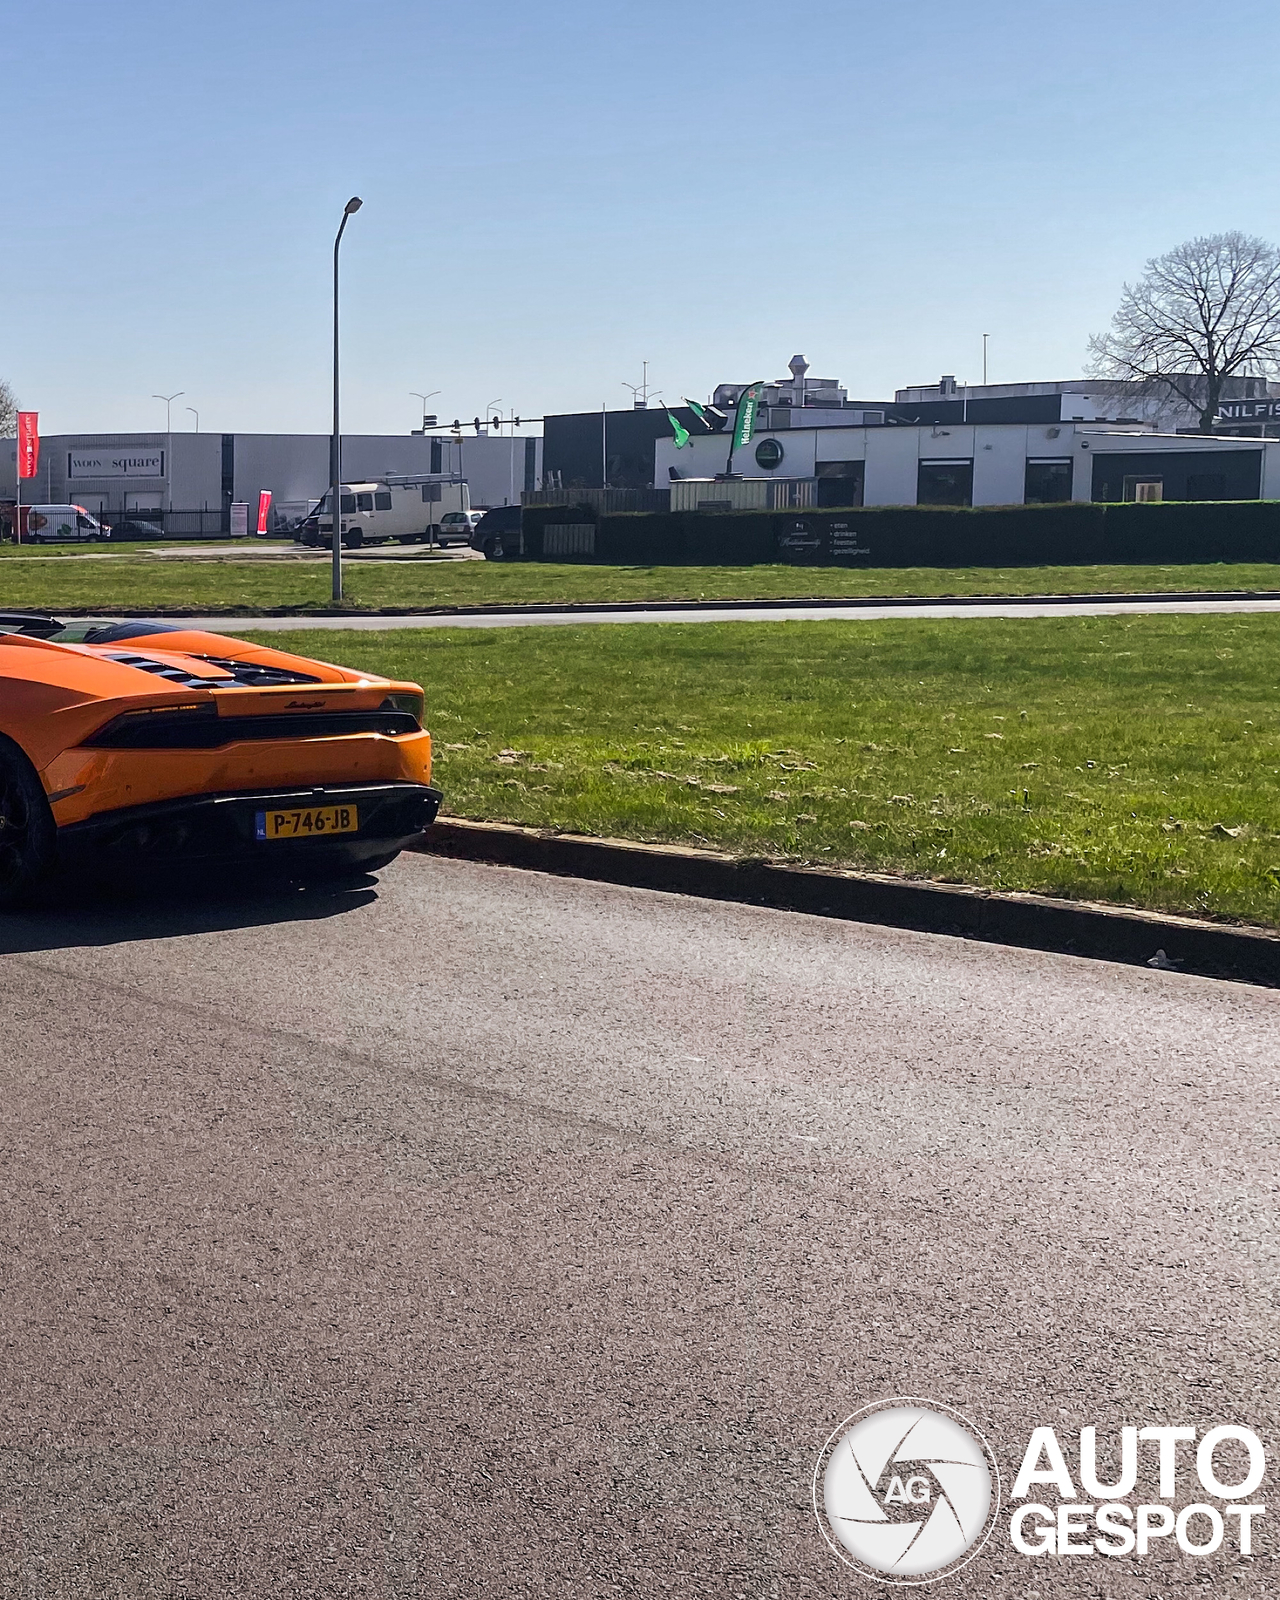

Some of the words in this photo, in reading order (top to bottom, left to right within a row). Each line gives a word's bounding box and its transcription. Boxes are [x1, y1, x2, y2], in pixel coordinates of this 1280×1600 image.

[740, 401, 754, 445] Heineken
[111, 457, 160, 472] square
[273, 808, 351, 835] P-746-JB
